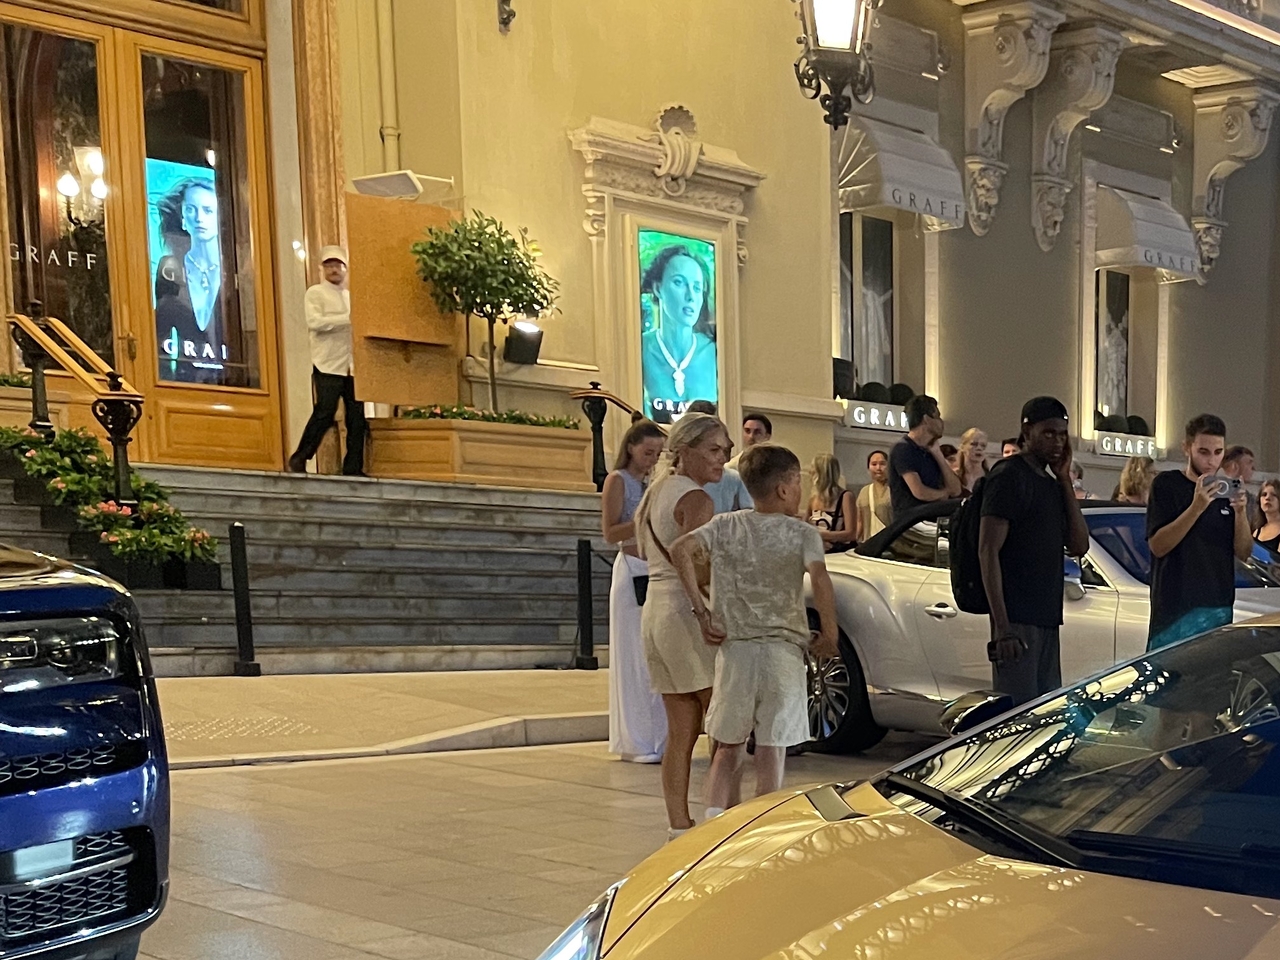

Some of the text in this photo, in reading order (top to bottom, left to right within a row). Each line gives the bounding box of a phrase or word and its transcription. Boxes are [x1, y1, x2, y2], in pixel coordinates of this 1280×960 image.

[892, 188, 961, 219] GRAFF
[9, 242, 97, 270] GRAFF
[1144, 249, 1196, 272] GRAFF
[1102, 436, 1154, 455] GRAFF
